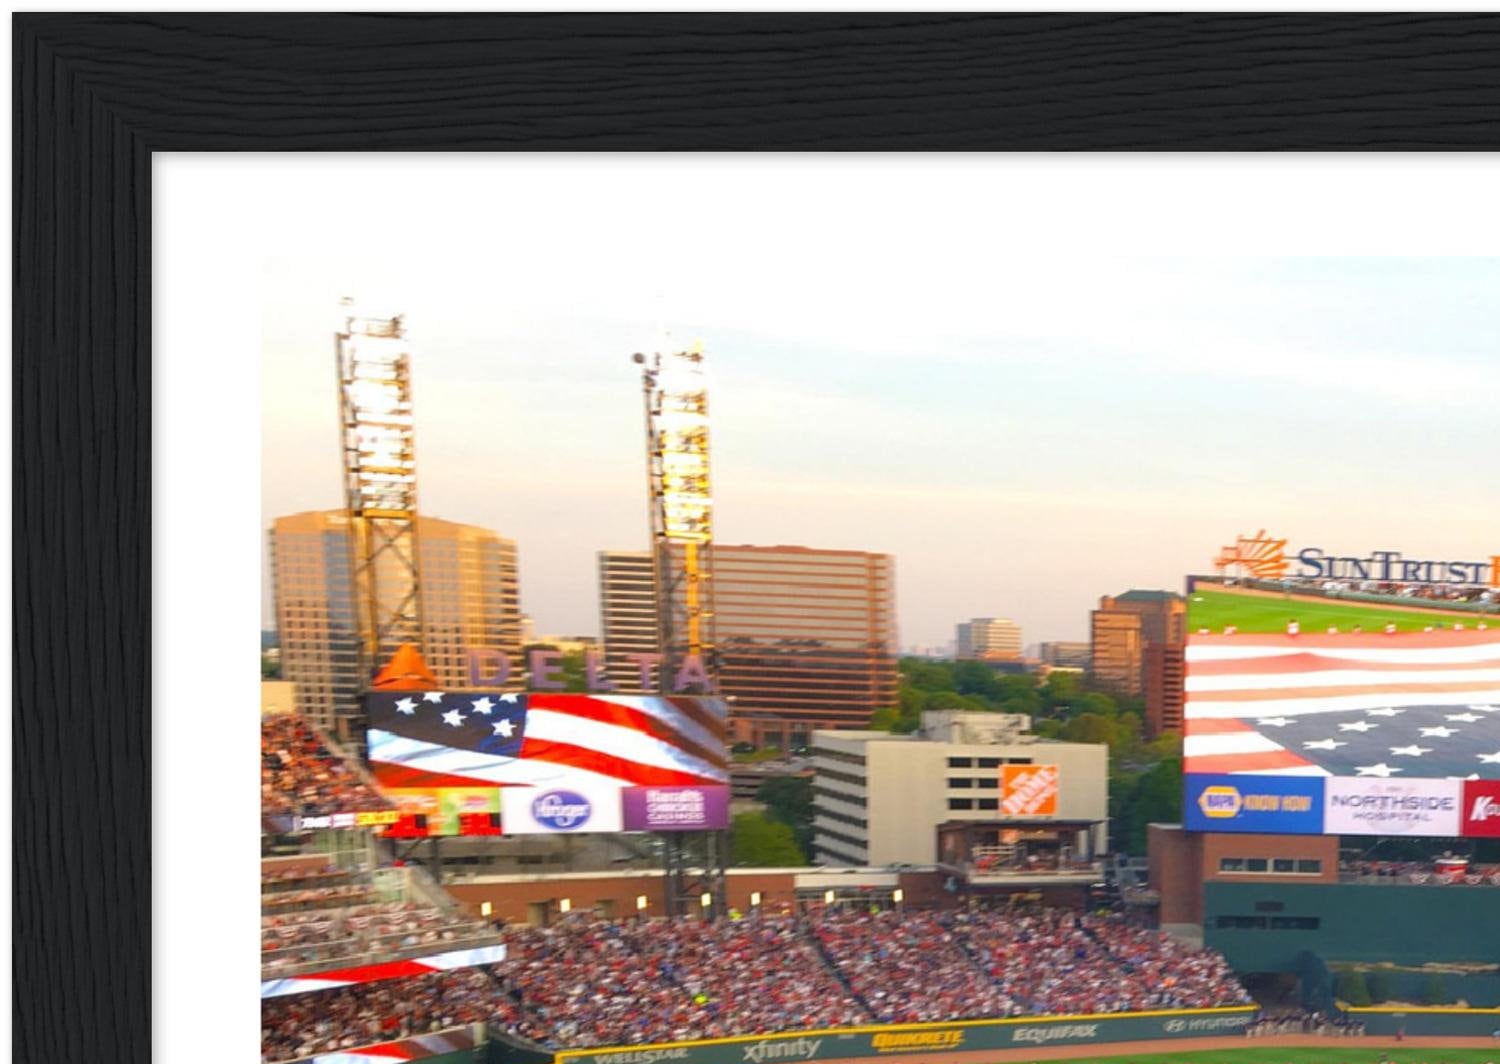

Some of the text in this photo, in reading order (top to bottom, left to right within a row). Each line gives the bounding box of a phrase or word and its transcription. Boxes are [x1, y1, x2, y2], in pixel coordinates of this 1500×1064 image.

[469, 650, 714, 691] DELTA
[1331, 794, 1455, 811] NORTHSIDE
[1352, 811, 1433, 823] HOSPITAL
[872, 1030, 965, 1048] QUIKRETE
[1012, 1024, 1097, 1043] EQUIFAX
[743, 1038, 822, 1063] xfinity
